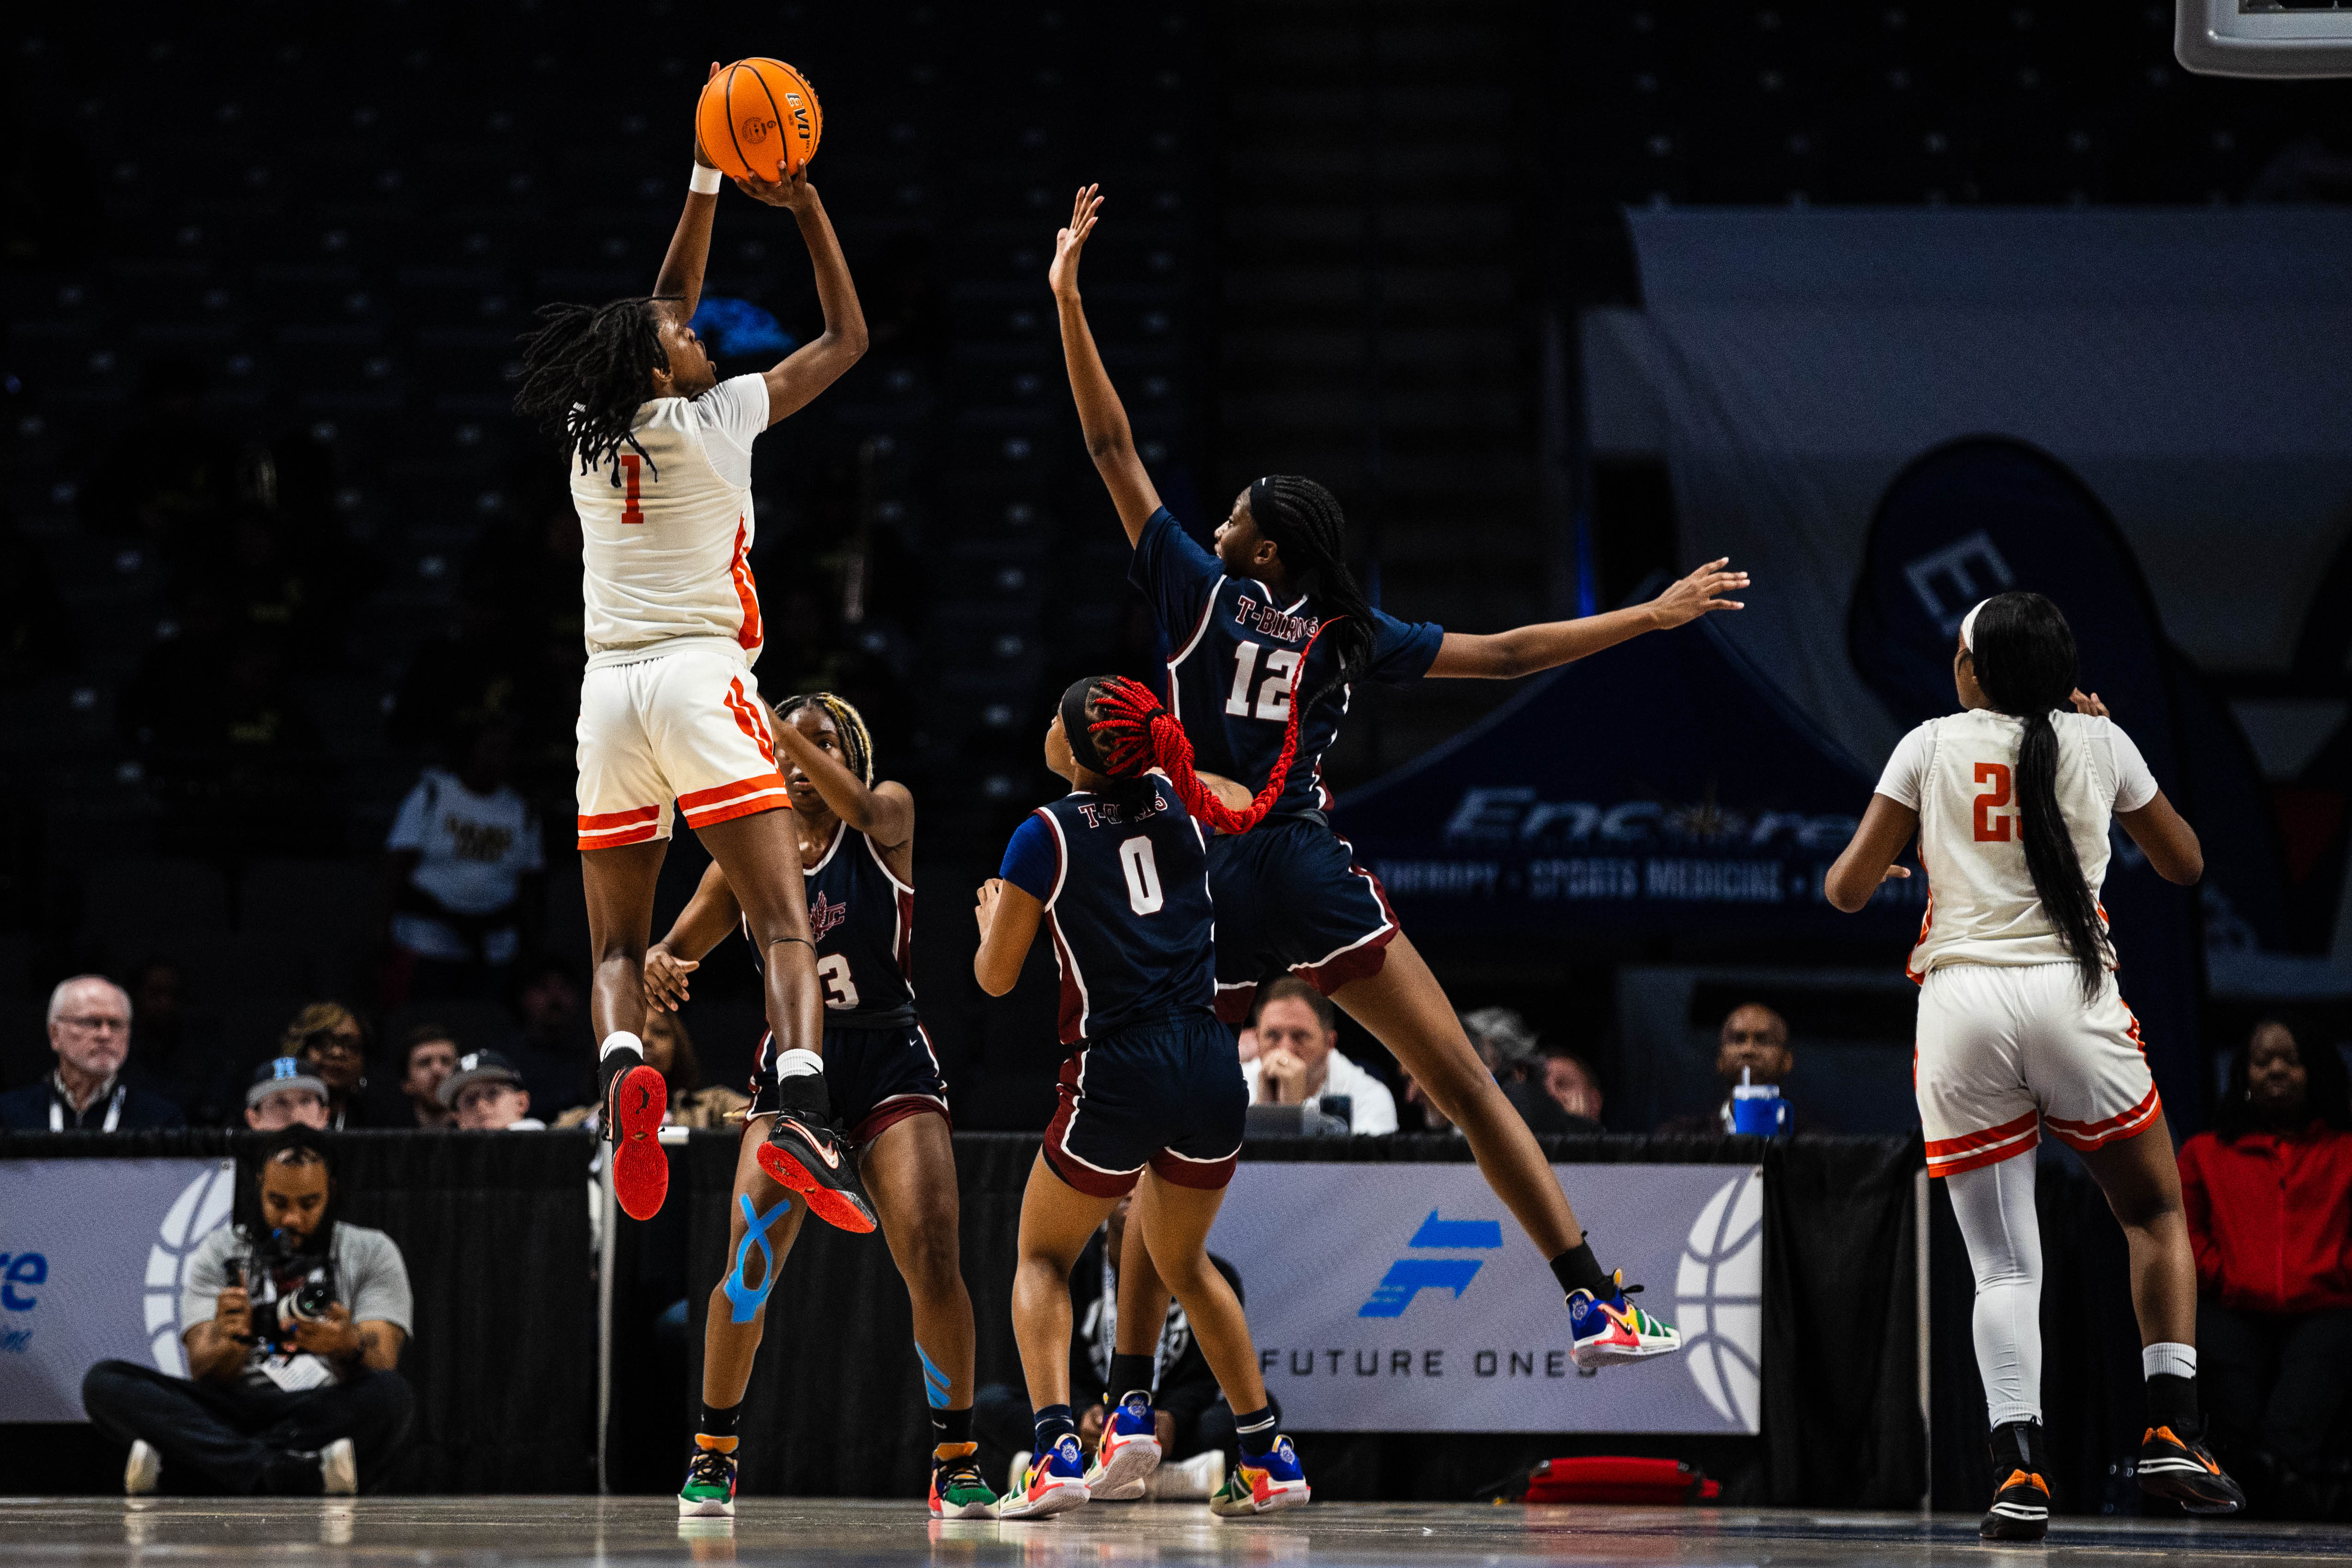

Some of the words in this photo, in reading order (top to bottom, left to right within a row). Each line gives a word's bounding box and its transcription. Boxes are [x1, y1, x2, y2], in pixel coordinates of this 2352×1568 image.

[620, 454, 644, 524] 1
[1235, 595, 1319, 643] T-BIRDS
[1225, 640, 1304, 722] 12
[1973, 762, 2025, 843] 2
[1119, 835, 1166, 917] 0
[1262, 1348, 1444, 1378] FUTURE
